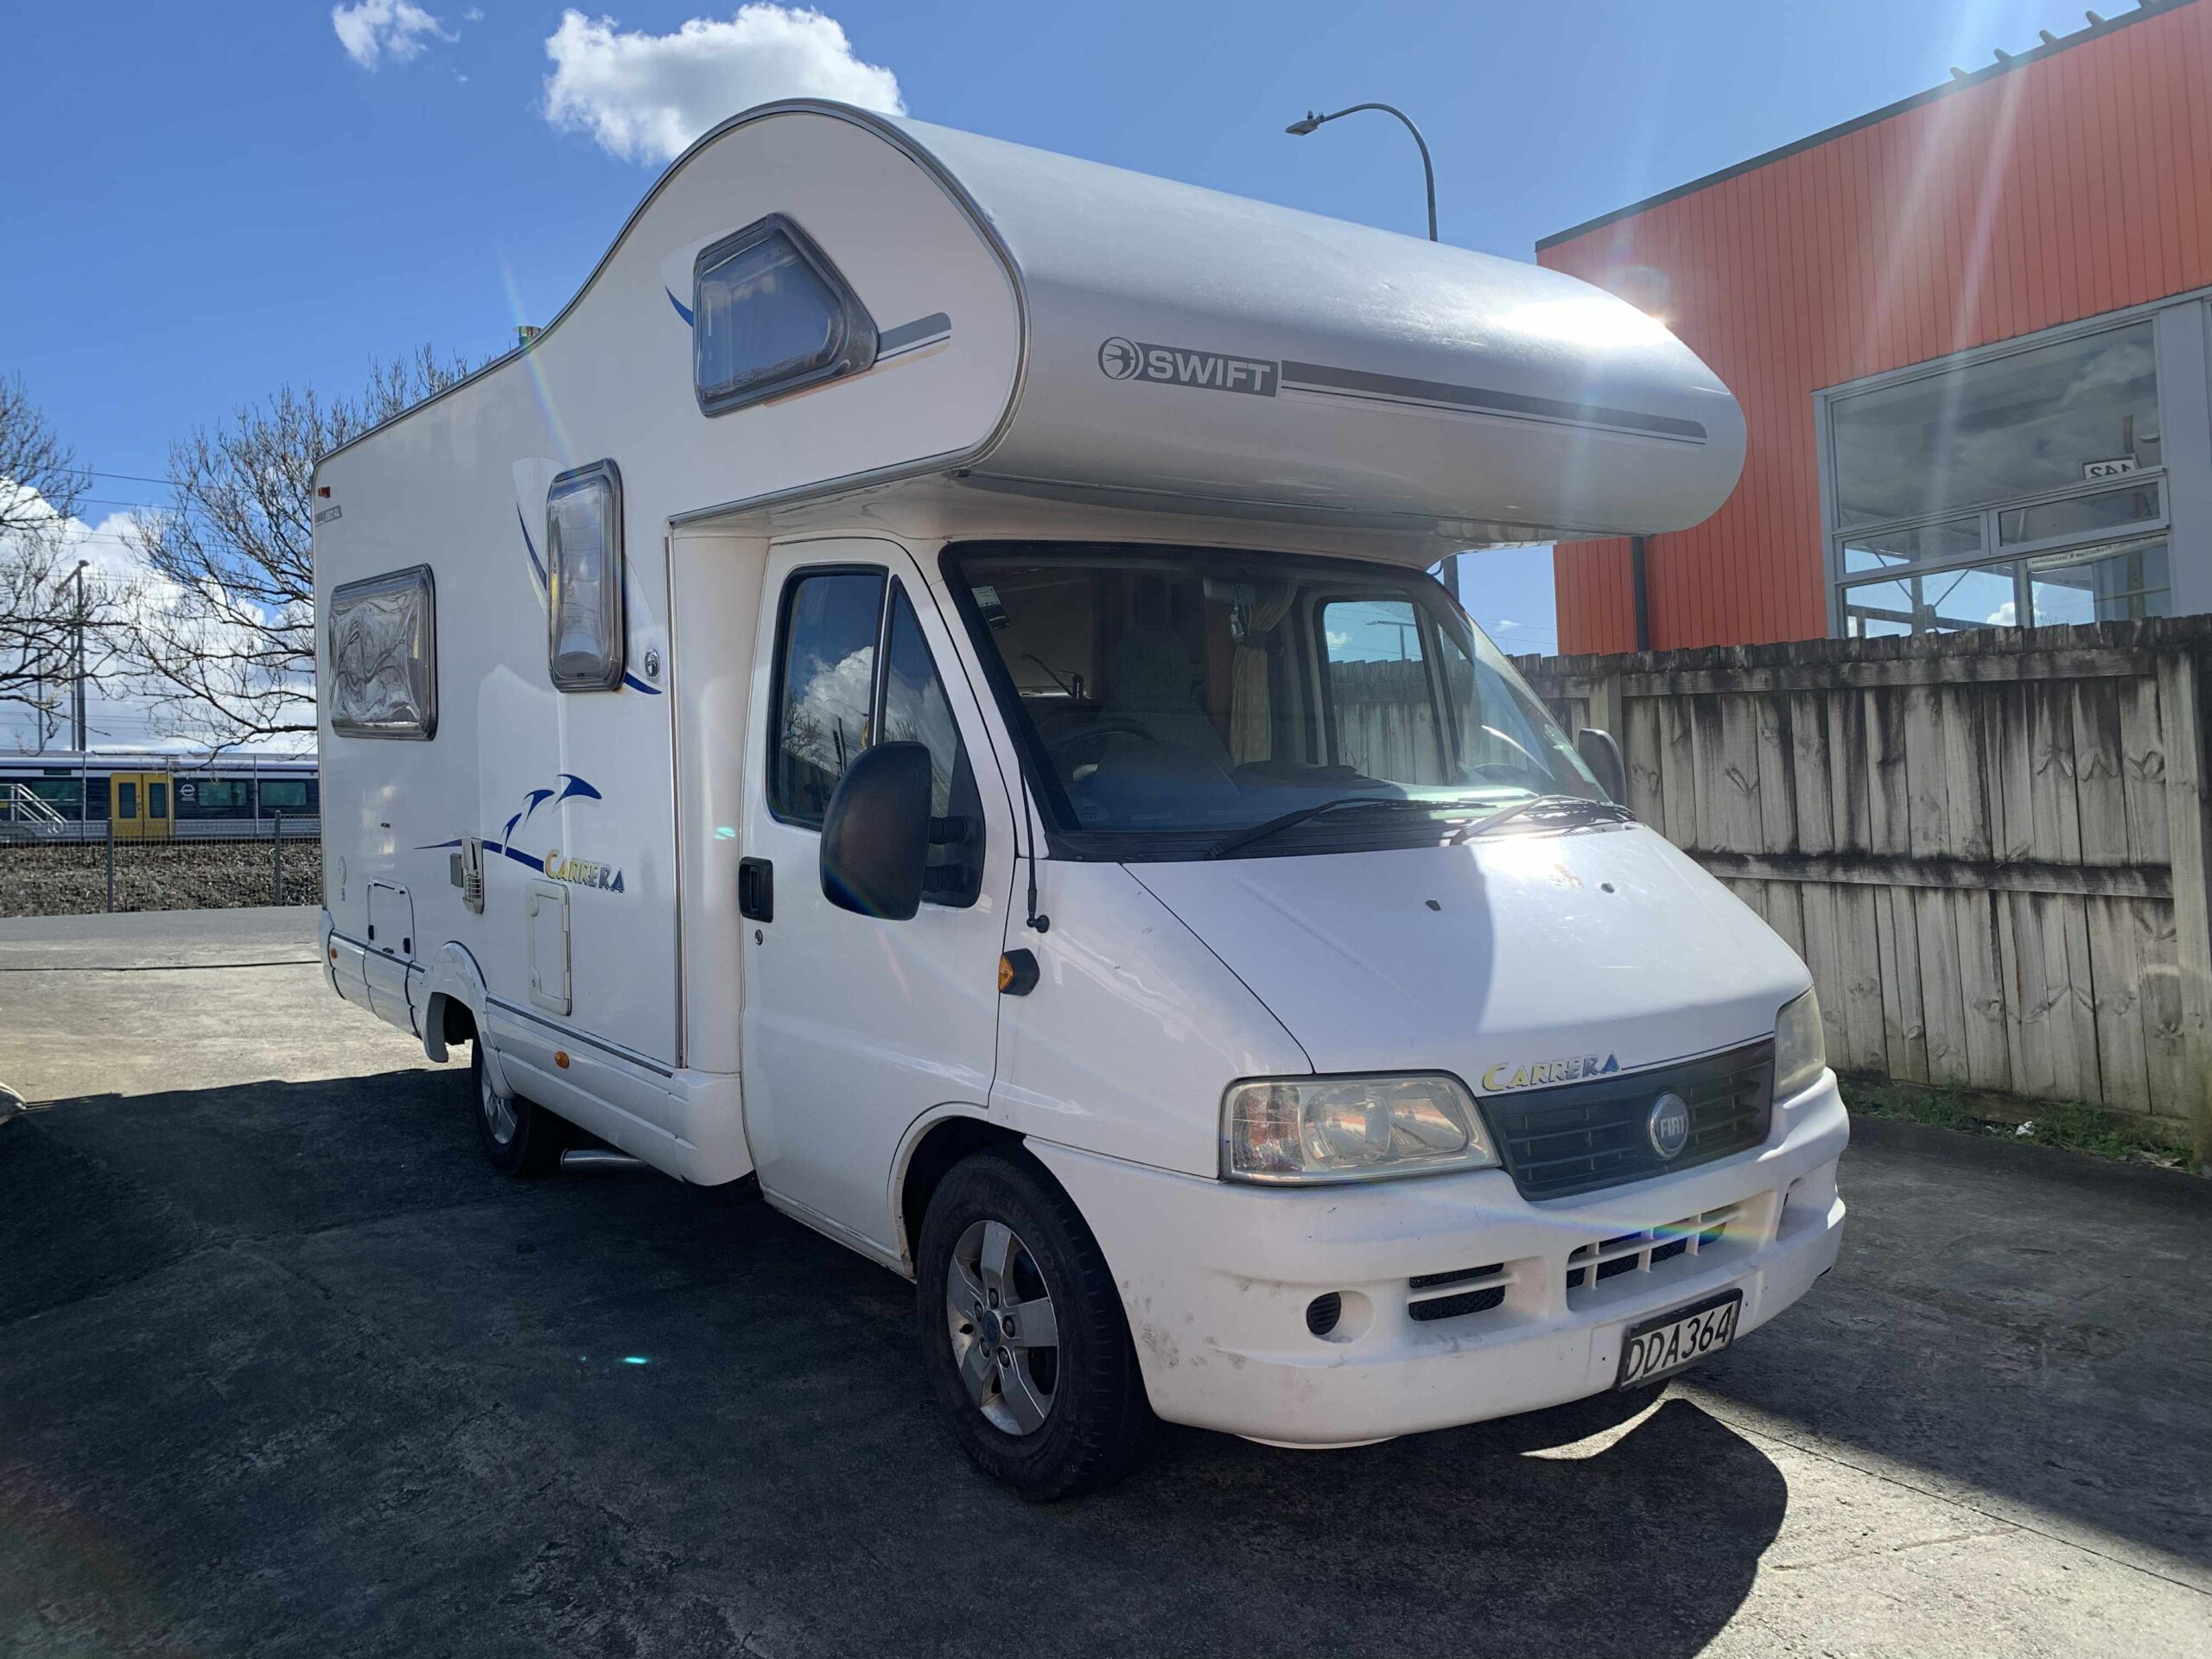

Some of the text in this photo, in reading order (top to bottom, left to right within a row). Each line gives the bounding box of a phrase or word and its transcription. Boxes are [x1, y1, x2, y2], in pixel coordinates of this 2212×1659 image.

[1147, 349, 1271, 391] SWIFT
[544, 849, 626, 893] CARRERA
[1482, 1052, 1620, 1092] CARRERA
[1659, 1114, 1686, 1139] FIAT
[1622, 1302, 1734, 1382] DDA364
